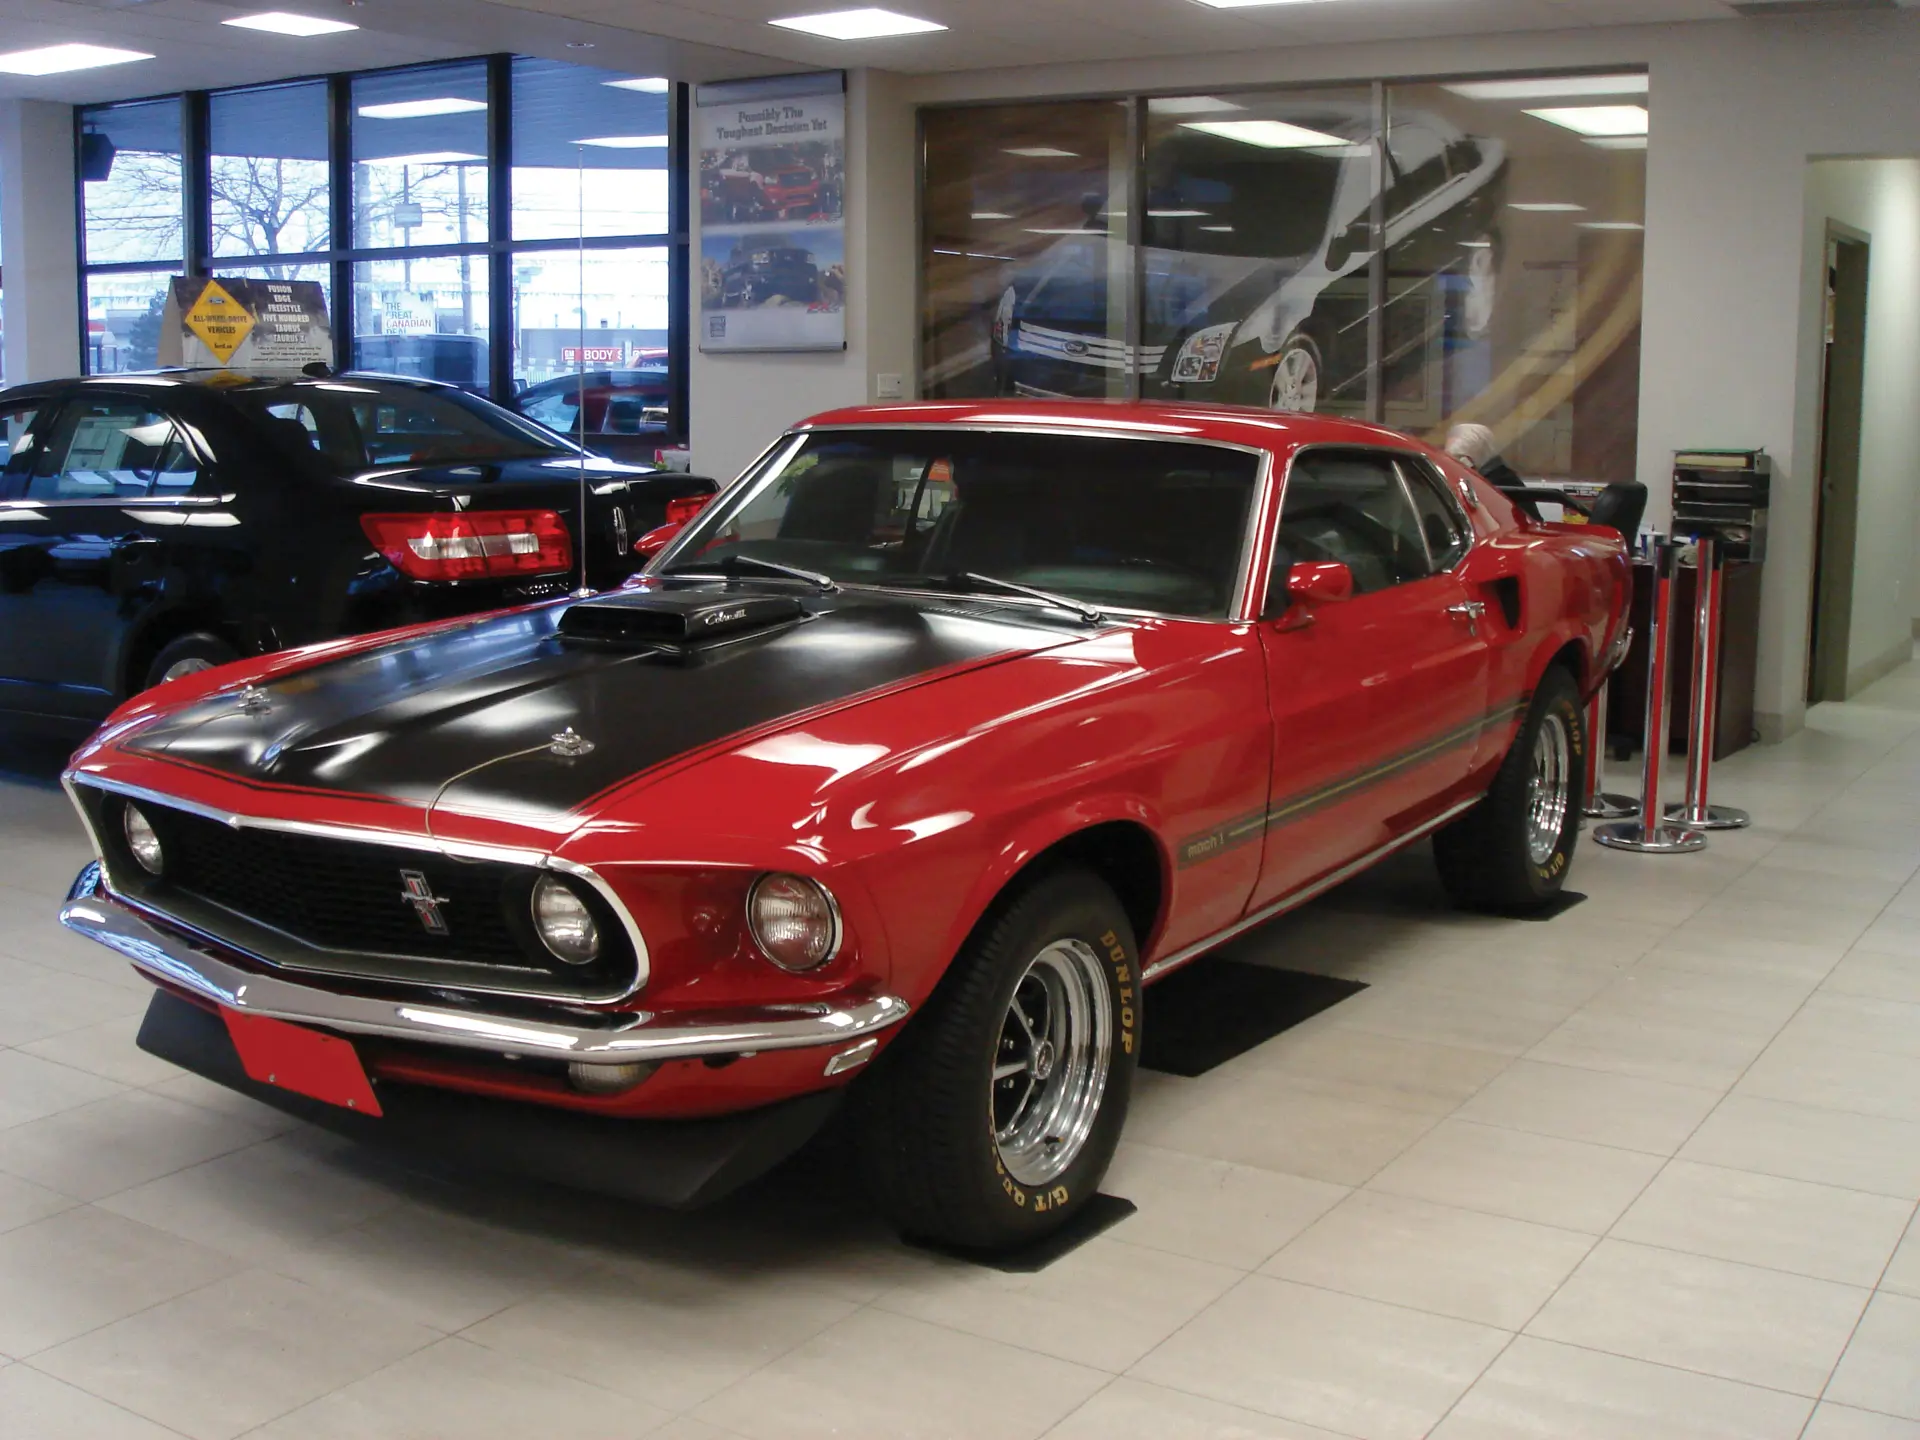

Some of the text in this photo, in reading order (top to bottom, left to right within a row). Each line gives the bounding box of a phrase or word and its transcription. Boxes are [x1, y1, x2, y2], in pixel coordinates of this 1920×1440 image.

[738, 106, 803, 123] Possibly The
[716, 118, 827, 140] Toughest Decision Yet
[267, 285, 292, 294] FUSION
[273, 294, 291, 303] EDGE
[267, 304, 301, 313] FREESTYLE
[386, 302, 401, 311] THE
[262, 313, 310, 323] FIVE HUNDRED
[386, 319, 432, 328] CANADIAN
[207, 326, 236, 334] VEHICLES
[275, 324, 301, 333] TAURUS
[273, 334, 299, 343] TAURUS
[564, 350, 575, 360] GM
[584, 349, 613, 361] BODY
[1100, 929, 1135, 1054] DUNLOP
[1035, 1185, 1069, 1212] G/T
